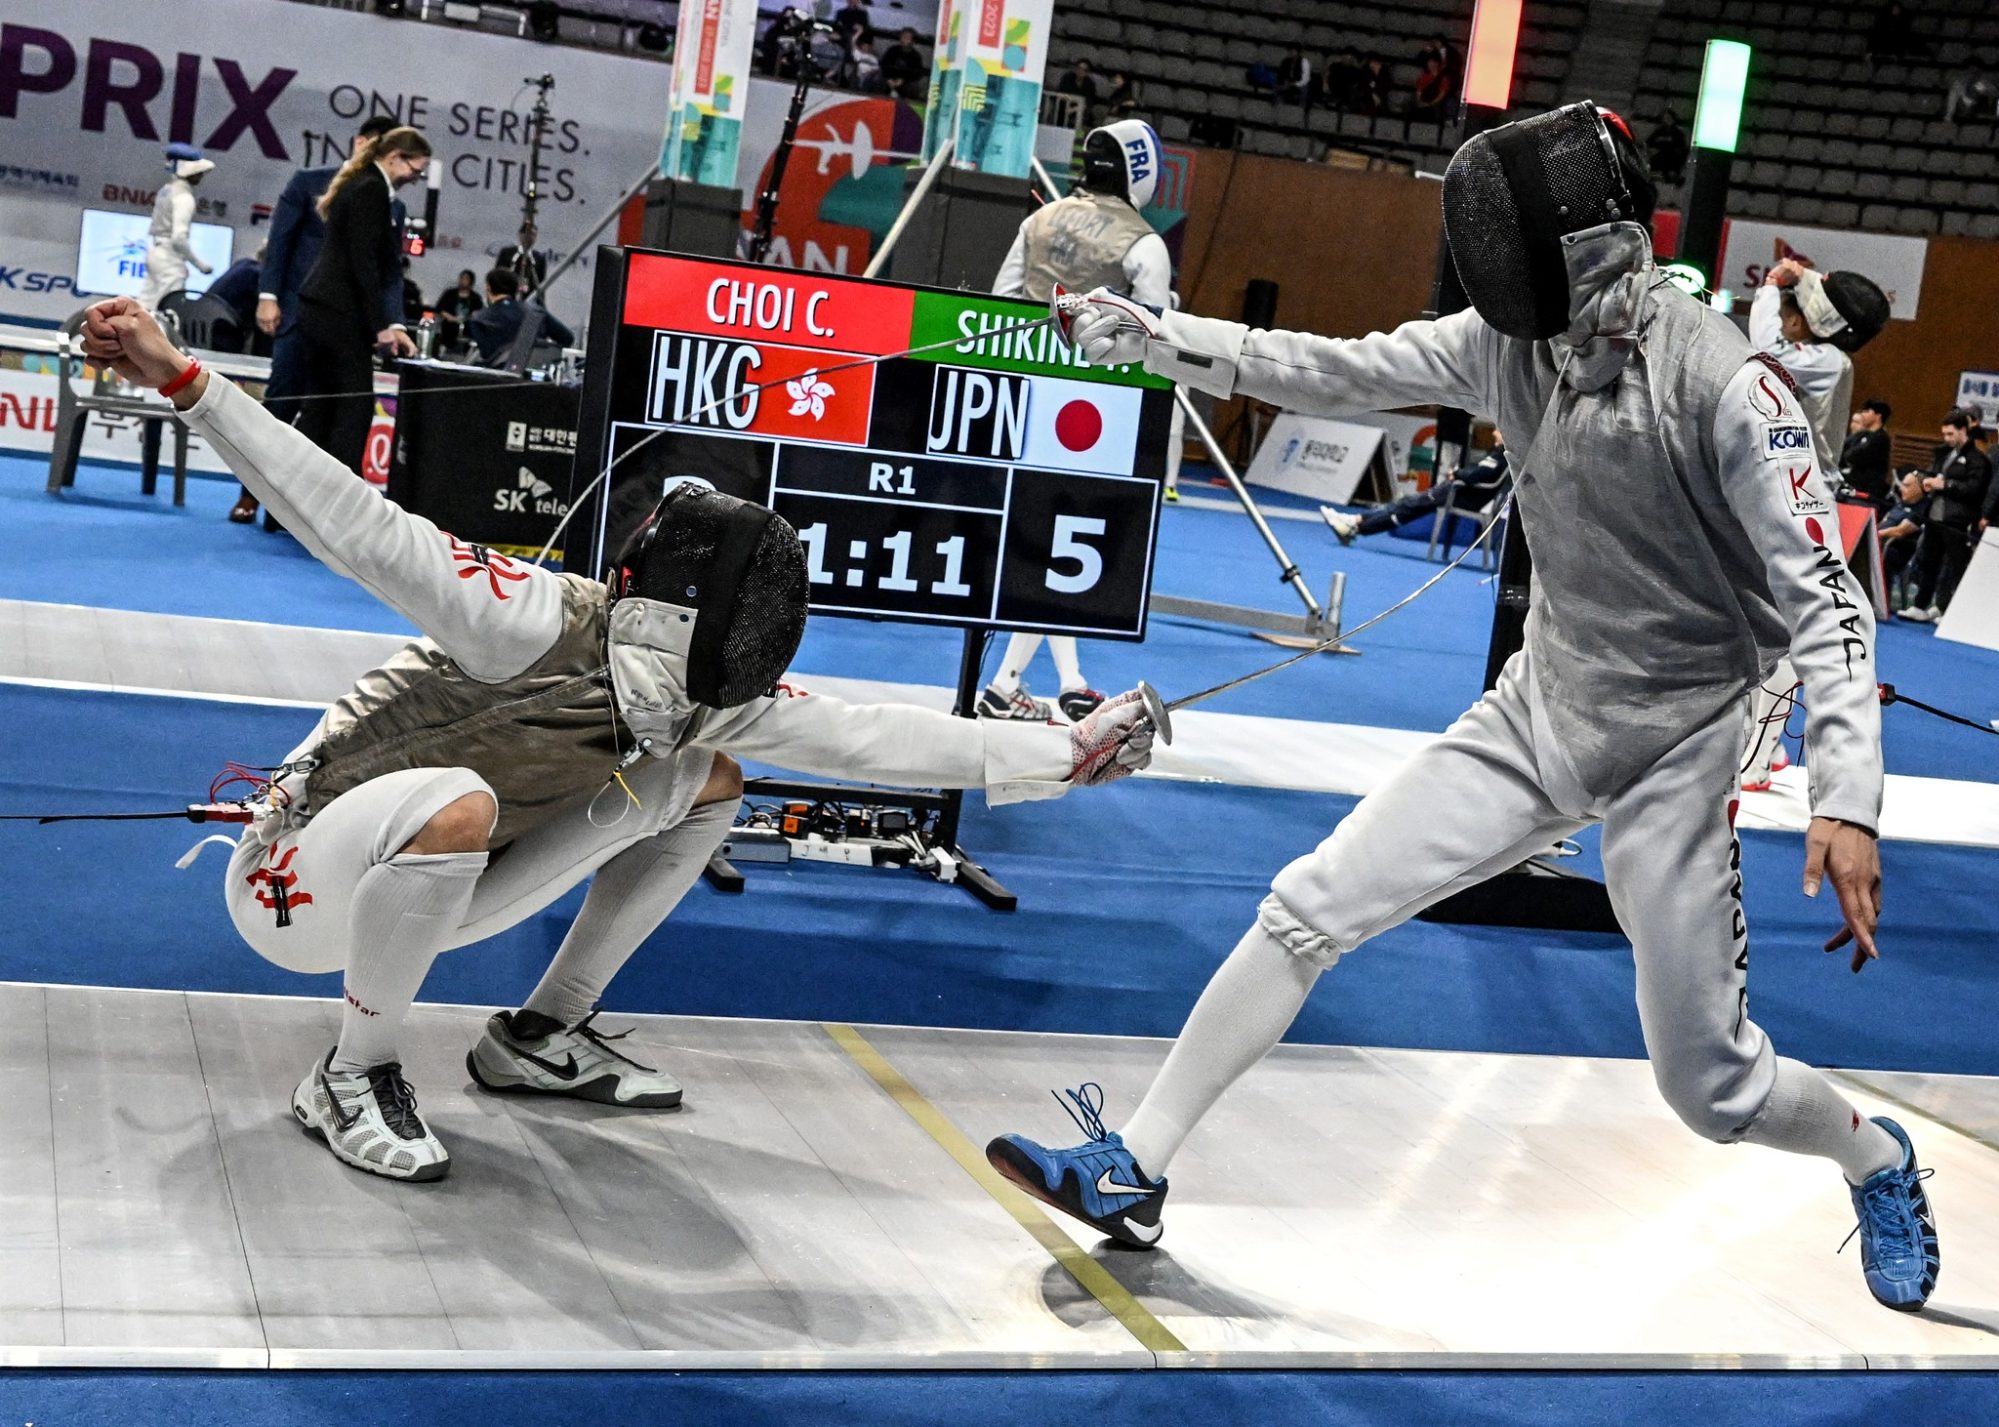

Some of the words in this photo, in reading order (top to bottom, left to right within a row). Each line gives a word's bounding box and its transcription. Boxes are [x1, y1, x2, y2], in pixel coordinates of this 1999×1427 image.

[0, 22, 298, 161] PRIX
[329, 84, 429, 131] ONE
[449, 102, 591, 157] SERIES.
[452, 152, 586, 206] CITIES.
[1125, 138, 1150, 184] FRA
[706, 276, 797, 333] CHOI
[806, 290, 835, 338] C.
[652, 335, 762, 430] HKG
[928, 369, 1030, 460] JPN
[493, 488, 529, 513] SK
[868, 461, 916, 495] R1
[799, 521, 971, 597] 1:11
[1044, 514, 1106, 594] 5
[1813, 545, 1867, 682] JAPAN
